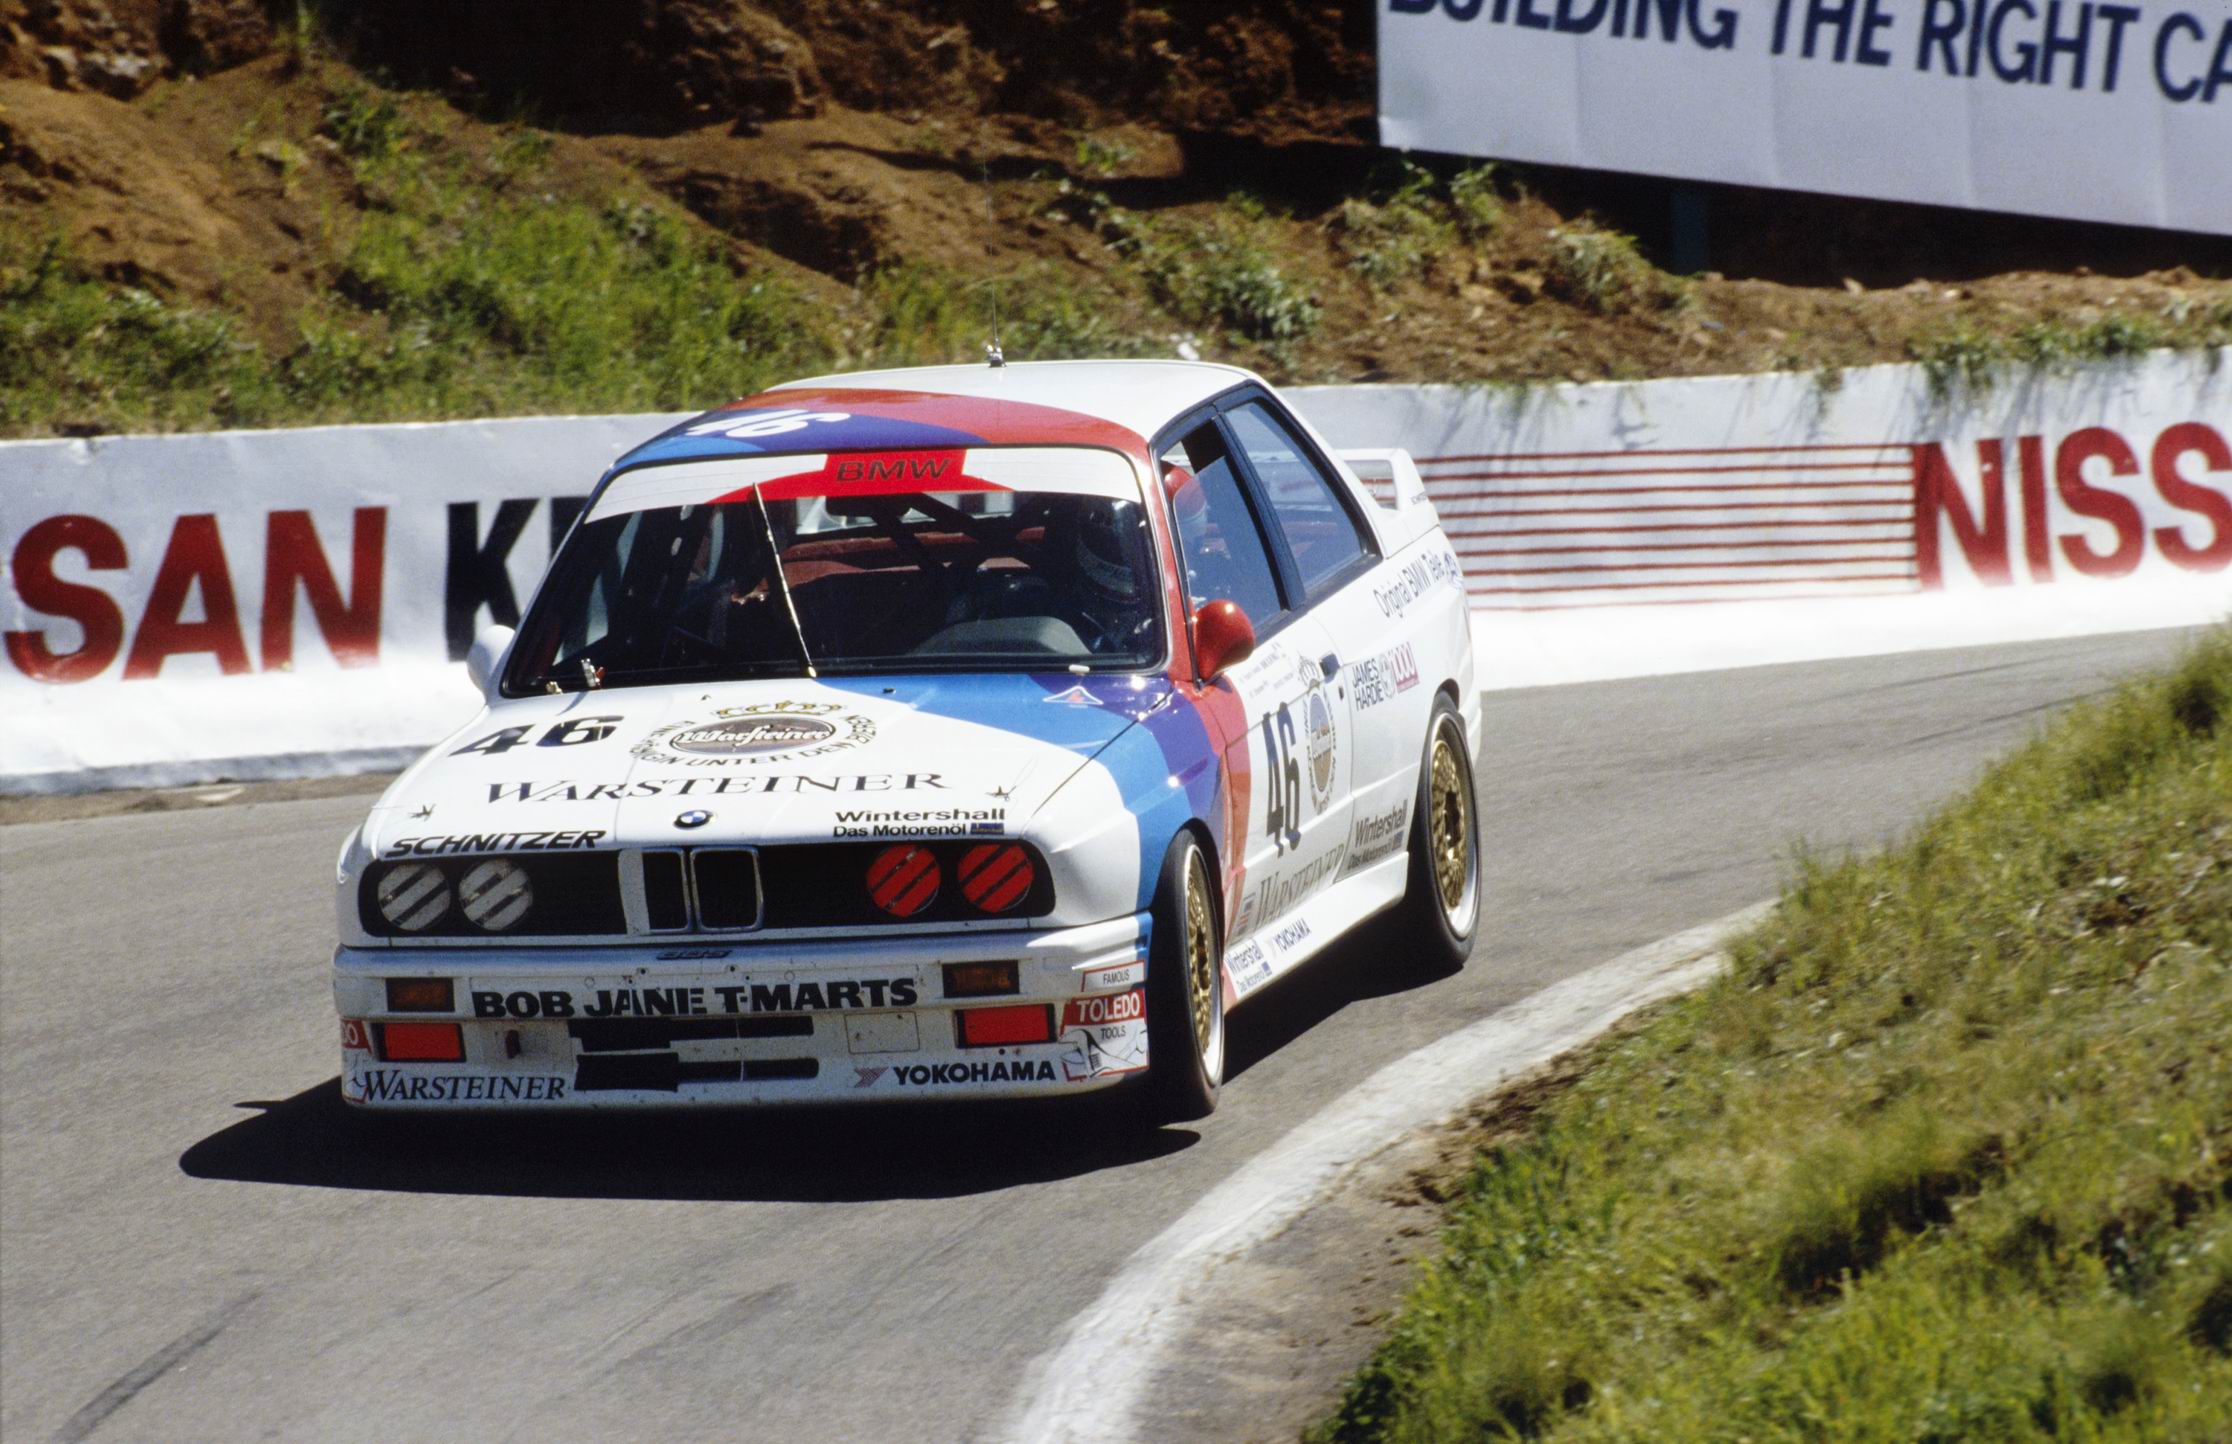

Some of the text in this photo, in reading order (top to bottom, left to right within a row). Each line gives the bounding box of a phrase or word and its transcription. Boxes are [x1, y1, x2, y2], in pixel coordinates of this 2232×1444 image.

[1916, 0, 2141, 92] RIGHT
[836, 457, 951, 482] BMW
[1911, 421, 2232, 592] NISS
[4, 496, 592, 684] SAN K
[1402, 558, 1431, 598] BMW
[1352, 658, 1379, 689] JAMES
[1354, 680, 1385, 712] HARDIE
[448, 715, 625, 758] 46
[686, 754, 792, 767] UNTER
[486, 773, 953, 803] WARSTEINER
[1261, 701, 1302, 859] 46
[833, 825, 868, 838] Das
[873, 823, 967, 837] Motorenöl
[834, 808, 1005, 823] Wintershall
[385, 829, 608, 858] SCHNITZER
[1103, 969, 1131, 985] FAMOUS
[471, 978, 918, 1019] BOB JANE T-MARTS
[1075, 992, 1140, 1023] TOLEDO
[1100, 1025, 1127, 1041] TOOLS
[364, 1069, 566, 1101] WARSTEINER
[893, 1060, 1056, 1087] YOKOHAMA
